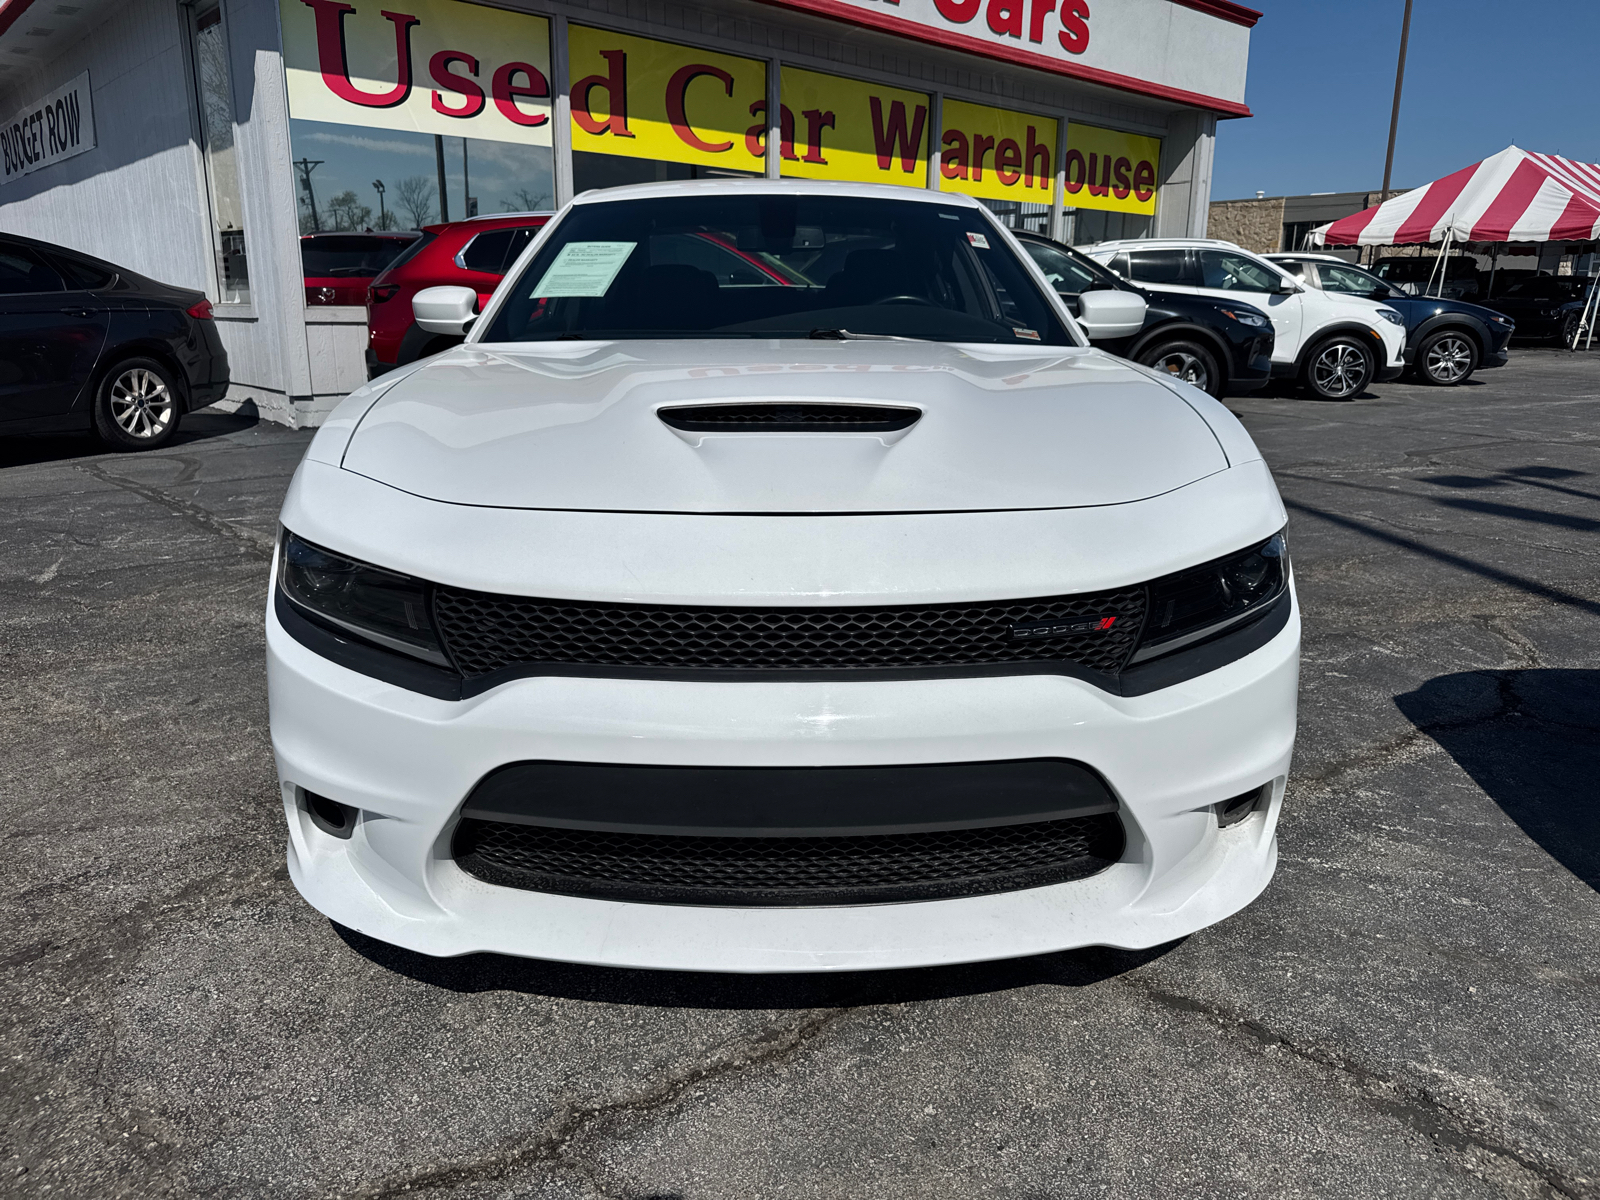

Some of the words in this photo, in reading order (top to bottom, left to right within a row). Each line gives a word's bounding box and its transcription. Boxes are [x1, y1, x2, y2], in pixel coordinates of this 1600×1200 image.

[0, 109, 43, 175] BUDGET
[45, 89, 80, 155] ROW
[305, 0, 635, 138] Used
[665, 63, 835, 165] Car
[869, 96, 1155, 202] Warehouse
